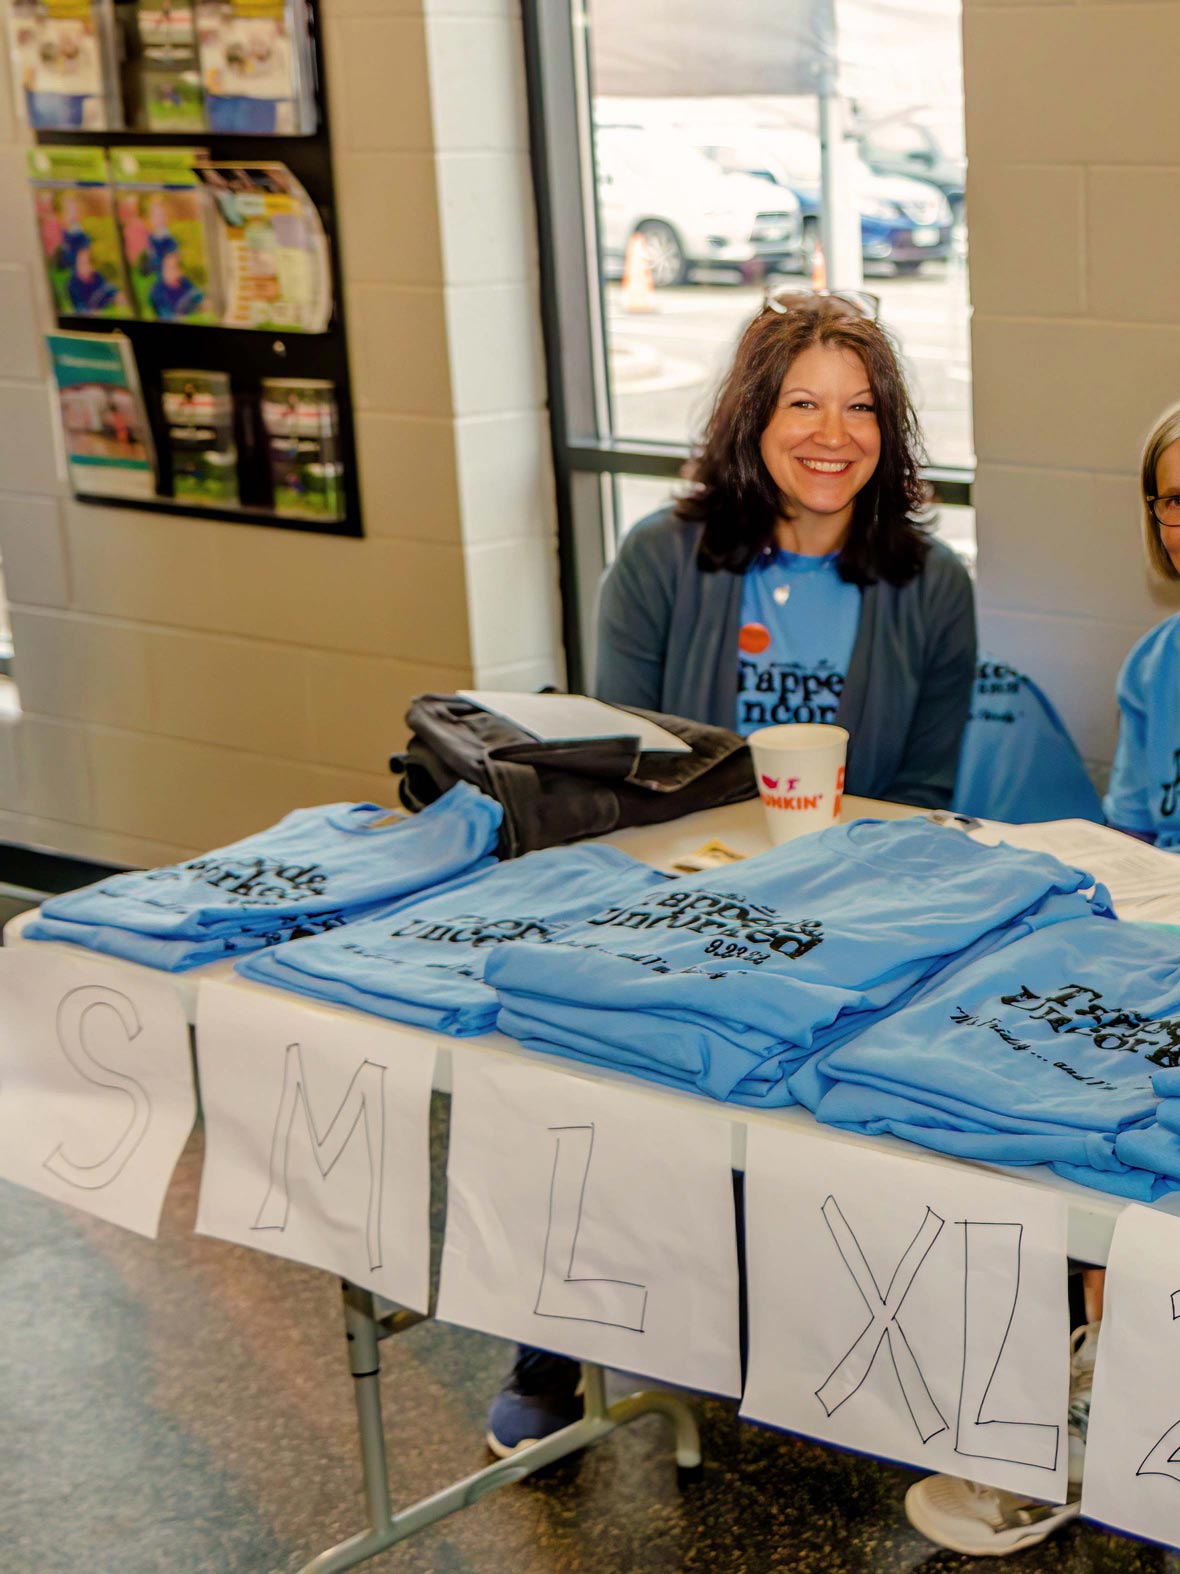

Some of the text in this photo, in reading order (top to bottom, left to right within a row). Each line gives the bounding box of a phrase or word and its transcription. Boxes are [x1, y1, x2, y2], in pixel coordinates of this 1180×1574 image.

[43, 984, 151, 1190] S
[250, 1042, 388, 1272] M
[533, 1121, 649, 1334] L
[814, 1194, 1060, 1472] XL
